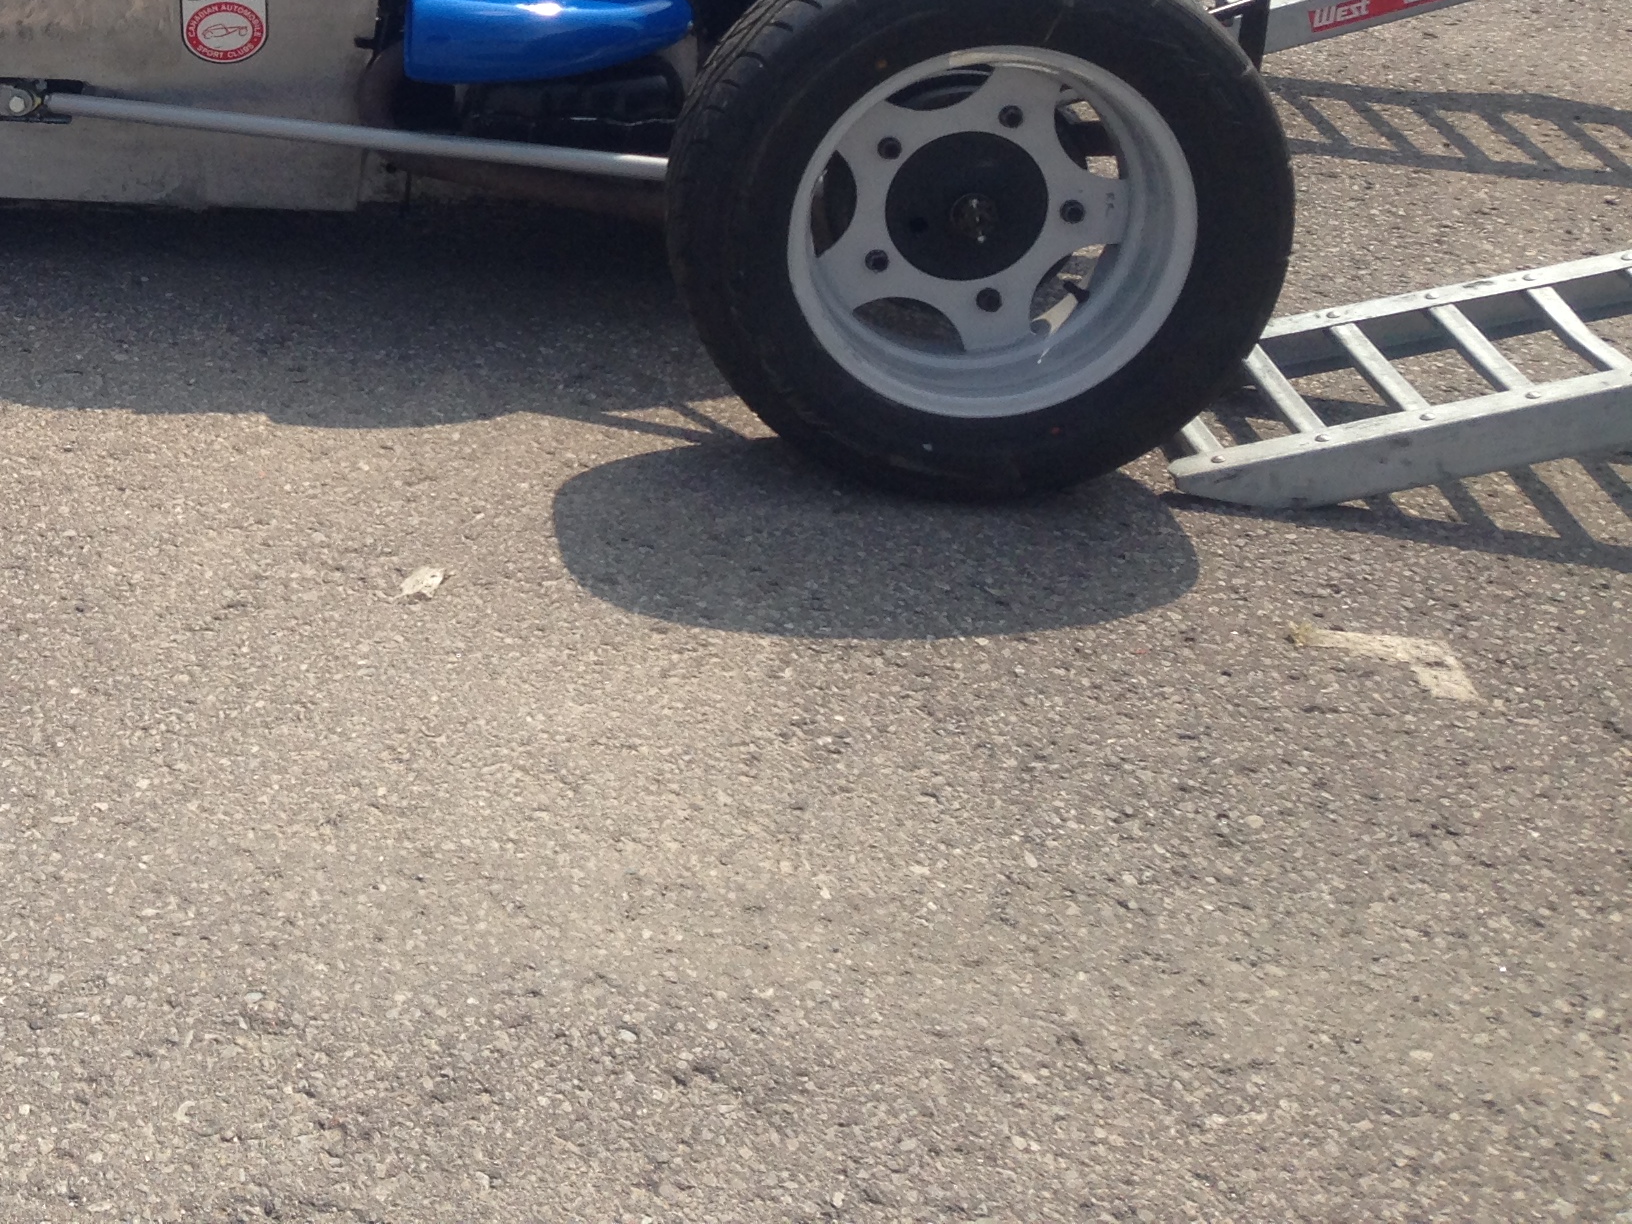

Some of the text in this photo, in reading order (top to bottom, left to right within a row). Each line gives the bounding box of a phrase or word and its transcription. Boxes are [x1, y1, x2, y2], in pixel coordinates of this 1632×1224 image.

[187, 4, 262, 38] CANADIAN AUTOMOBILE
[1314, 0, 1370, 27] West
[196, 43, 255, 59] SPORT CLUBS
